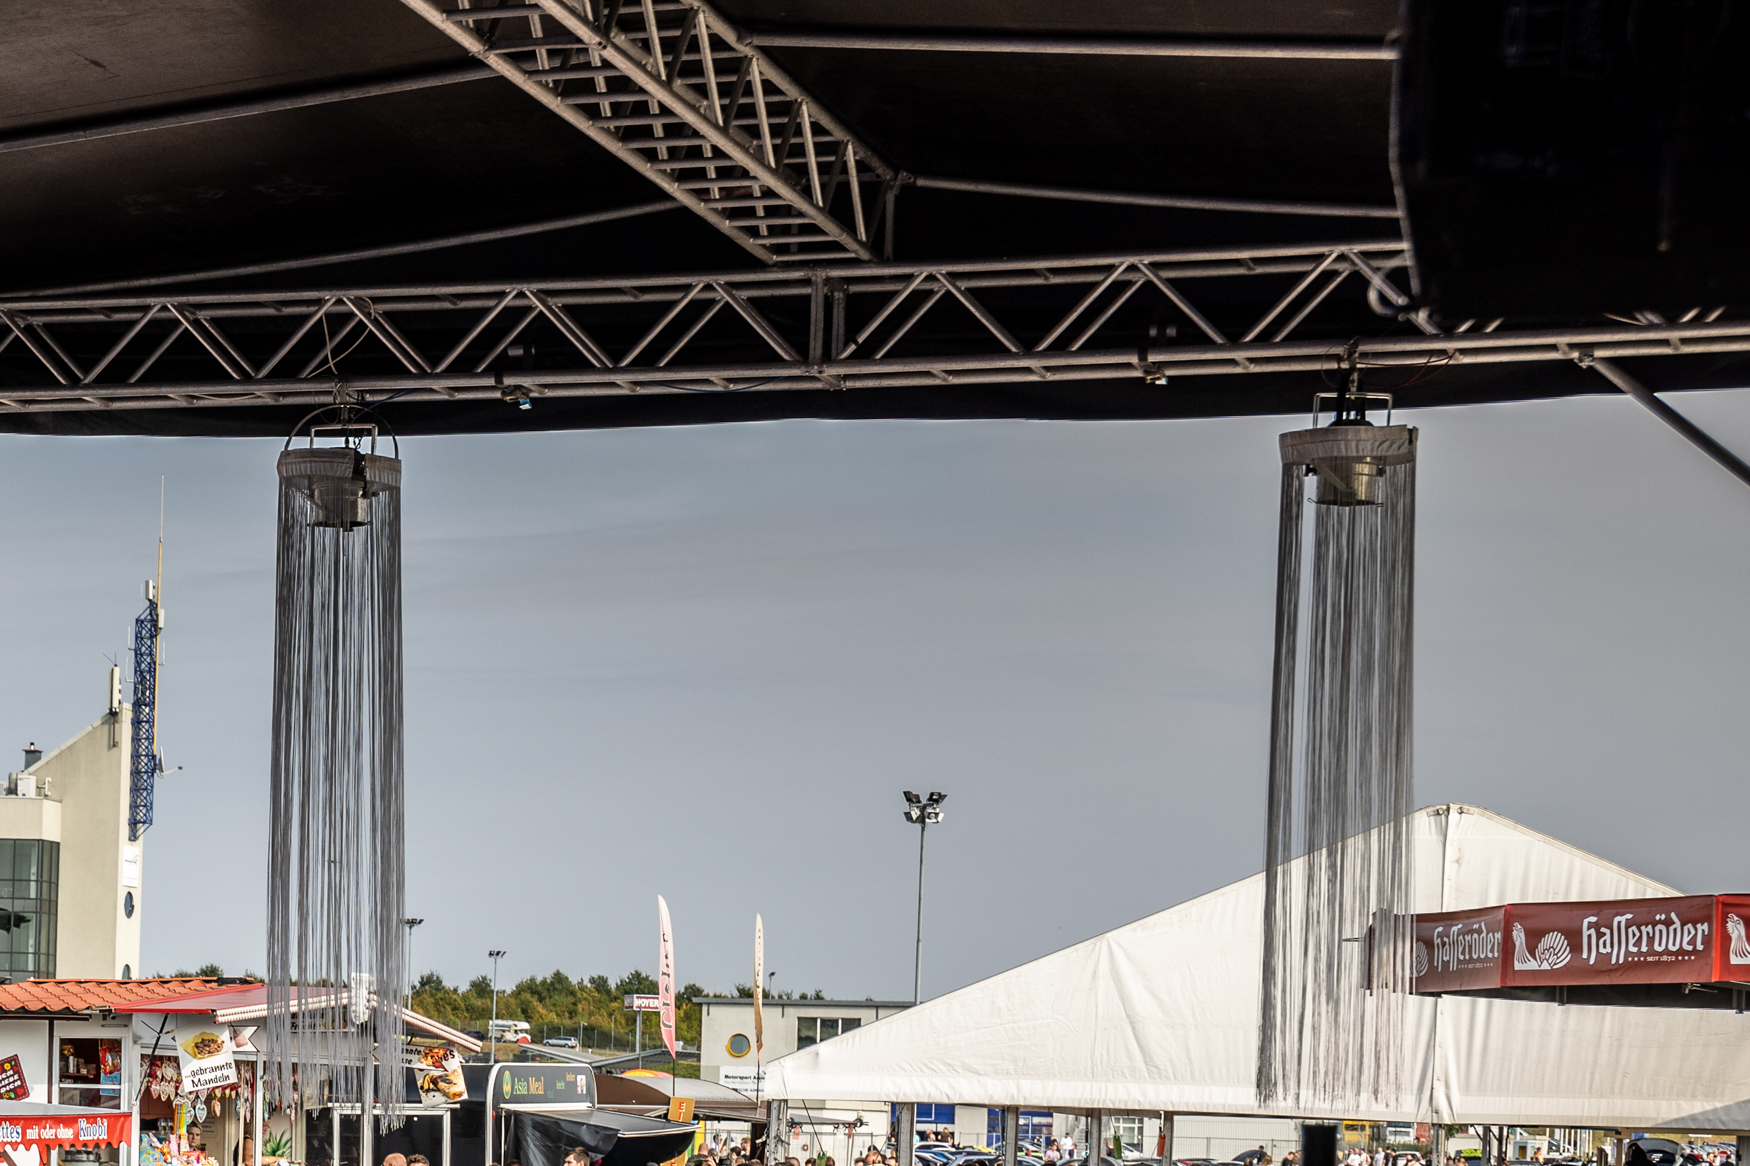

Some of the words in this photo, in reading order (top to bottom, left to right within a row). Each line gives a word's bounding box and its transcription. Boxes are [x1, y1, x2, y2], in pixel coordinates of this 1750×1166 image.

[635, 998, 659, 1008] HOYER
[0, 1080, 21, 1094] DICH
[191, 1074, 231, 1088] Mandeln
[513, 1077, 528, 1095] Asia
[528, 1076, 545, 1095] Meal
[26, 1125, 39, 1139] mit
[40, 1124, 56, 1139] oder
[57, 1124, 73, 1139] ohne
[78, 1117, 108, 1140] Knobi
